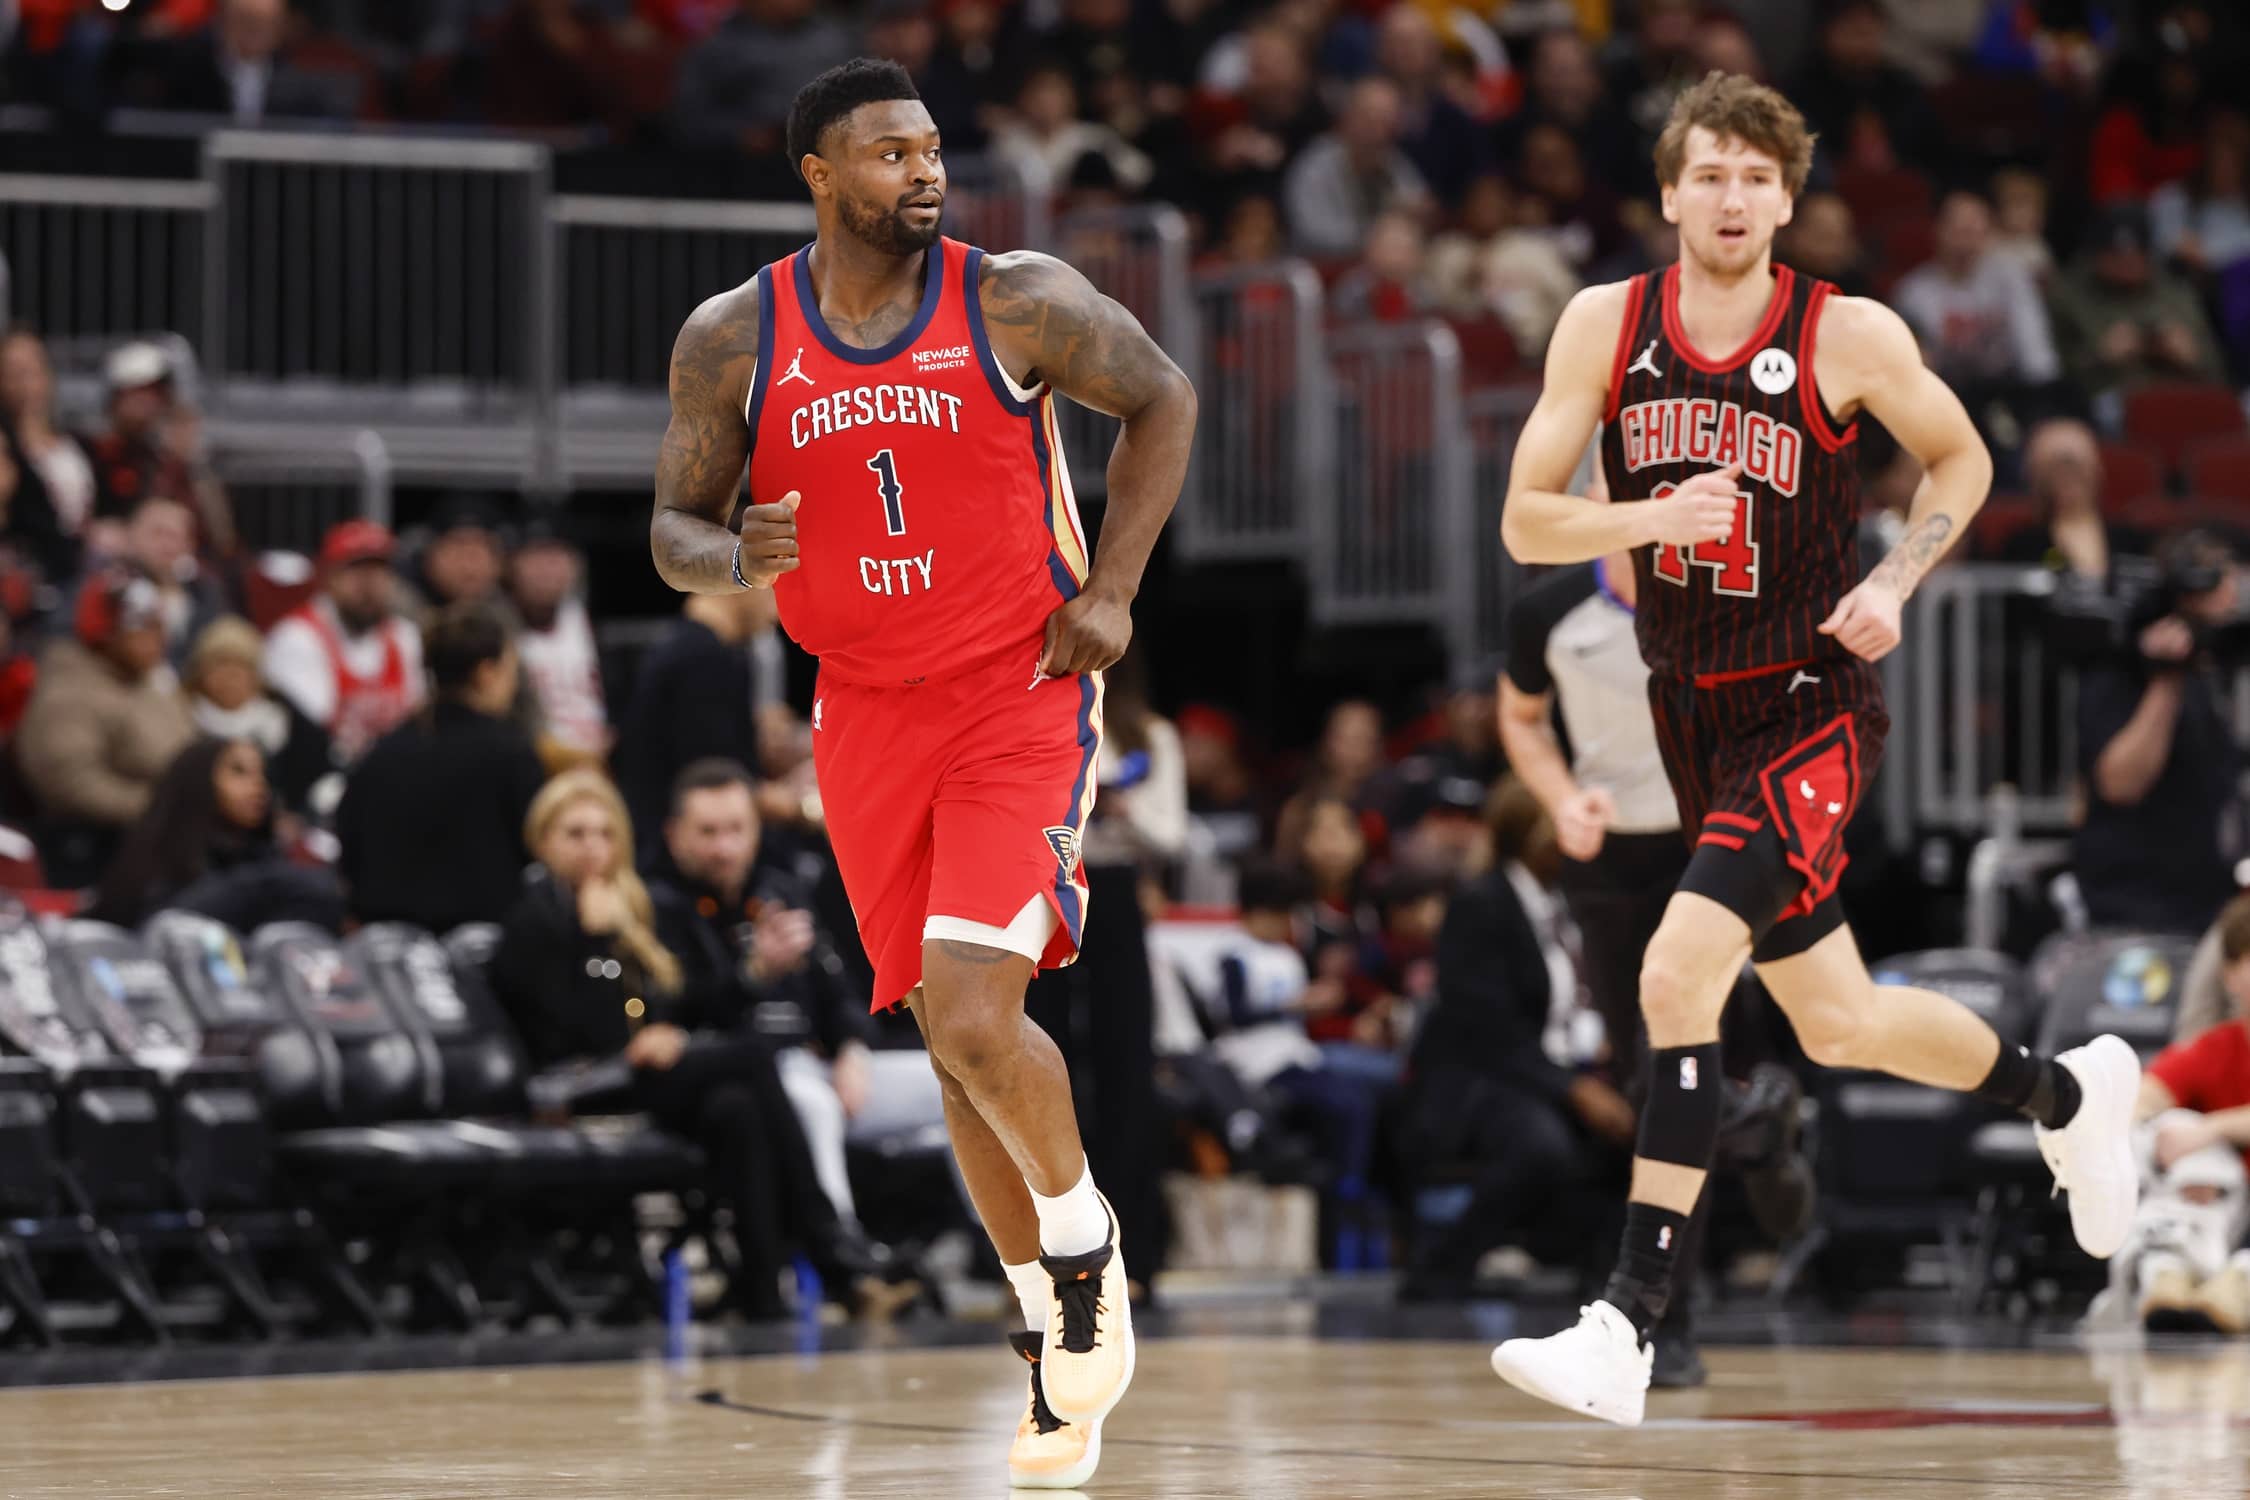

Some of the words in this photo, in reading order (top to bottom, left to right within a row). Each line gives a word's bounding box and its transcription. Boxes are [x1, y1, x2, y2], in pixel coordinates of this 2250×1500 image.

[911, 345, 970, 364] NEWAGE
[918, 359, 966, 372] PRODUCTS
[790, 384, 963, 449] CRESCENT
[1620, 397, 1802, 498] CHICAGO
[866, 448, 906, 536] 1
[858, 548, 935, 596] CITY
